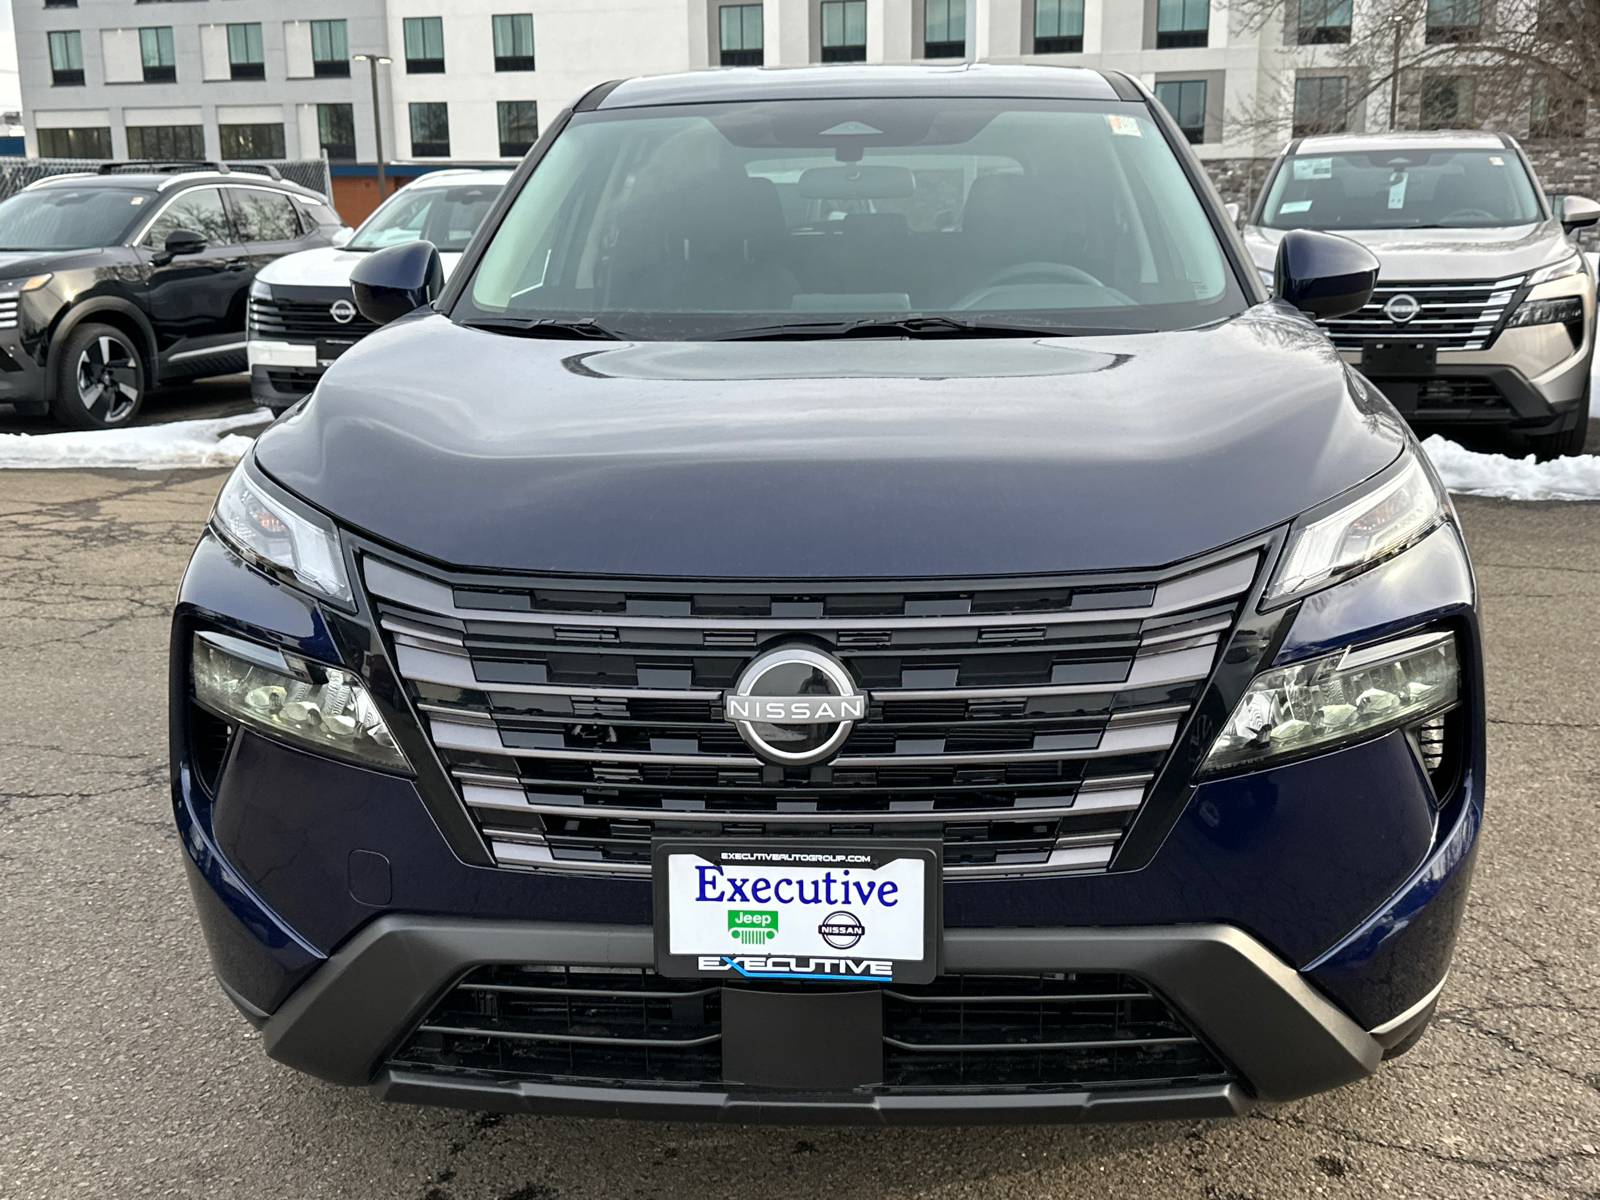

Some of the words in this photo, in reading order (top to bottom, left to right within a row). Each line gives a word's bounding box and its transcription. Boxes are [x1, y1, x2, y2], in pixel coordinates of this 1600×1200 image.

[730, 700, 861, 719] NISSAN
[720, 852, 871, 863] EXECUTIVEAUTOGROUP.COM
[694, 865, 899, 907] Executive
[734, 911, 772, 926] Jeep
[821, 926, 862, 935] NISSAN
[697, 956, 893, 976] EXECUTIVE
